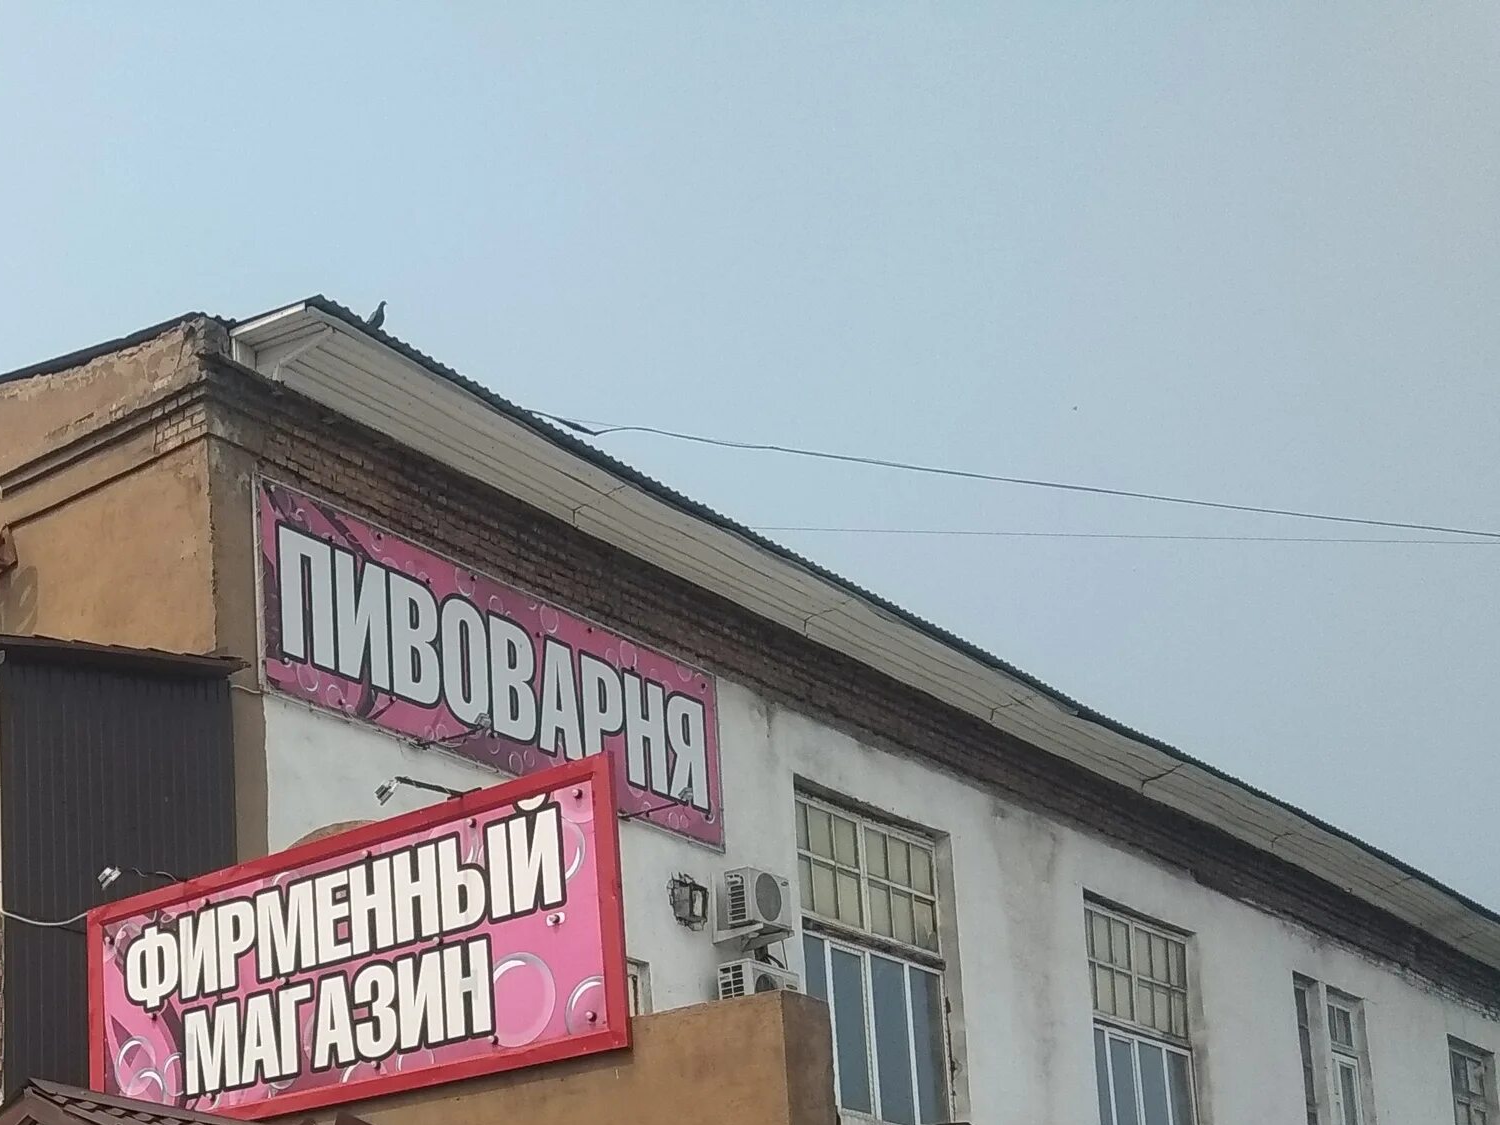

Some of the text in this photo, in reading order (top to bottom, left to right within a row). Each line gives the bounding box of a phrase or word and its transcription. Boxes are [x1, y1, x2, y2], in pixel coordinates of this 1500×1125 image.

[276, 521, 711, 814] ПИВОВАРНЯ
[124, 793, 567, 1012] ФИРМЕННЫЙ
[181, 932, 497, 1099] МАГАЗИН
